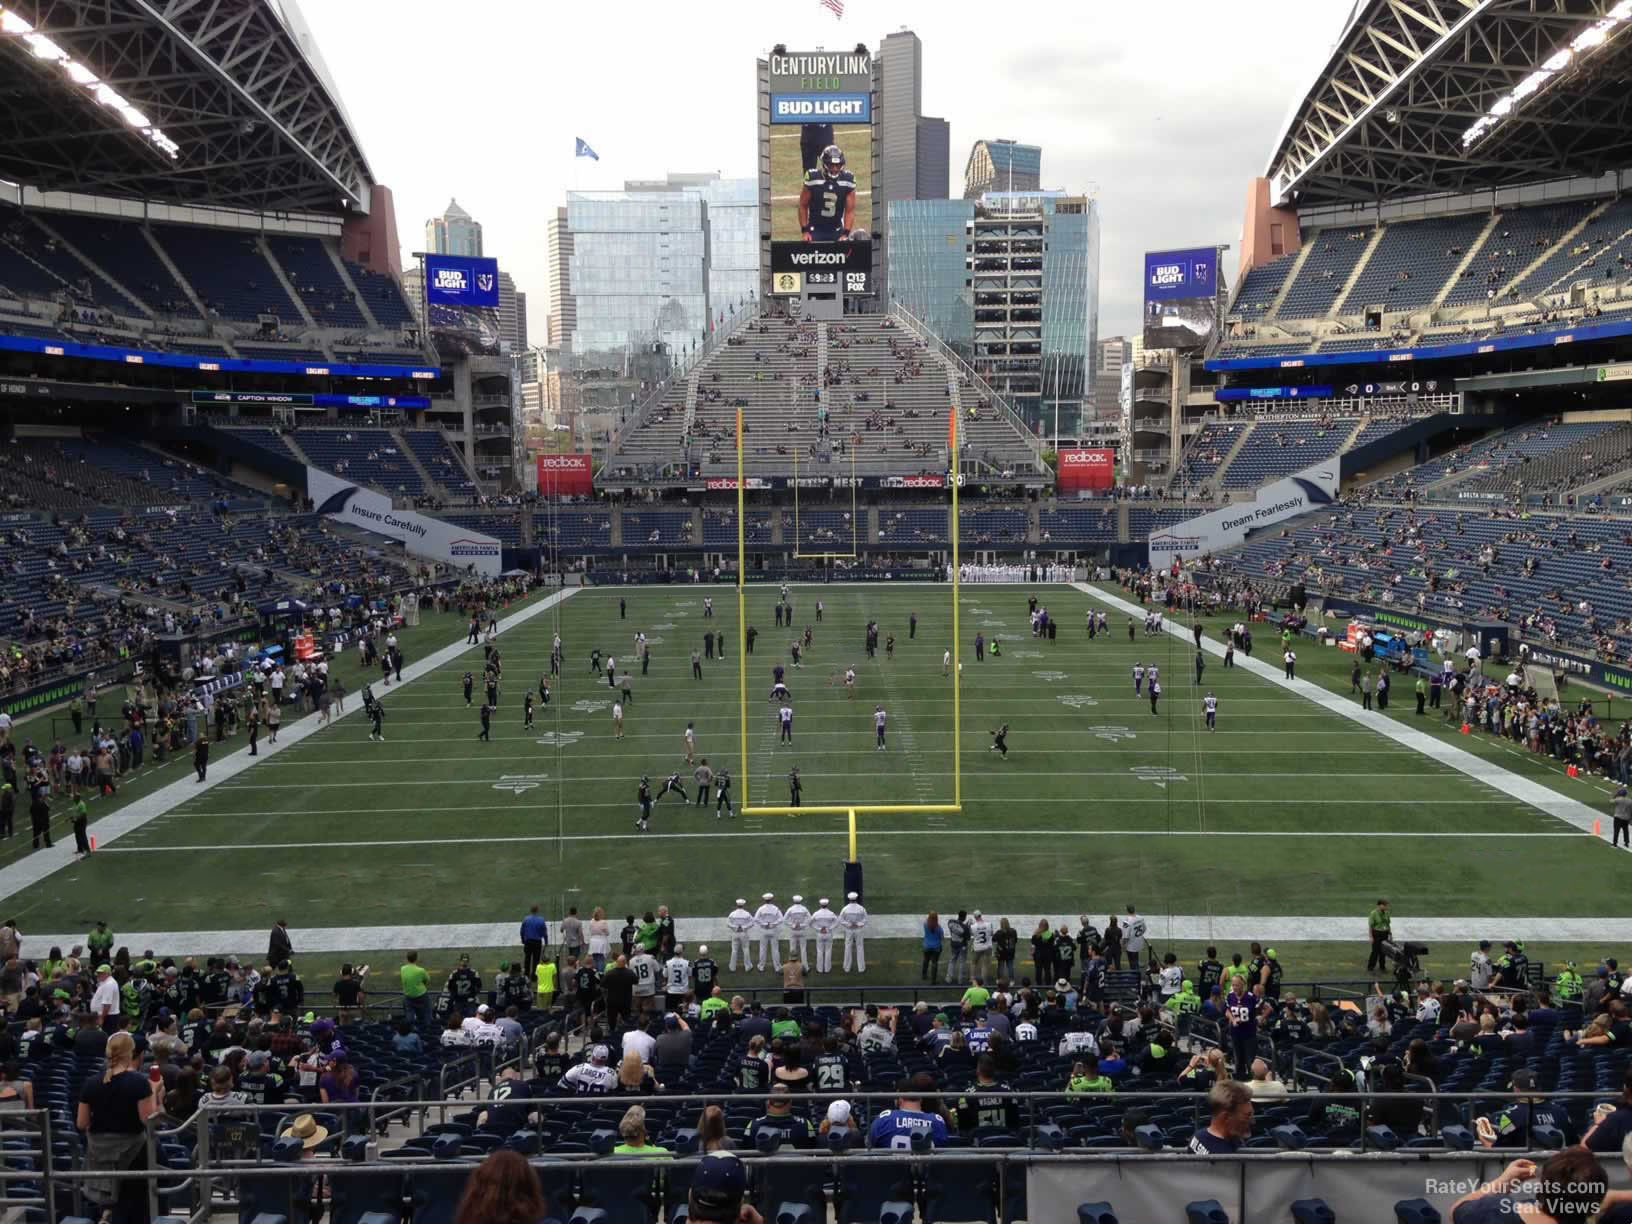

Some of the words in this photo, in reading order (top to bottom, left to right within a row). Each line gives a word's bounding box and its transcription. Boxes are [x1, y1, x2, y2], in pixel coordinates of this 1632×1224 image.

[801, 78, 840, 89] FIELD
[779, 101, 813, 115] BUD
[815, 101, 862, 115] LIGHT
[821, 192, 837, 217] 3
[791, 250, 846, 264] verizon
[439, 270, 462, 280] BUD
[1156, 266, 1180, 275] BUD
[435, 278, 467, 289] LIGHT
[846, 273, 866, 283] Q13
[1152, 274, 1184, 284] LIGHT
[848, 283, 864, 292] FOX
[352, 503, 382, 522] Insure
[383, 514, 427, 537] Carefully
[1222, 514, 1254, 531] Dream
[1255, 496, 1304, 520] Fearlessly
[636, 963, 650, 979] 18
[673, 969, 682, 983] 3
[698, 967, 712, 982] 89
[456, 980, 472, 996] 12
[1180, 1002, 1201, 1014] 54
[1230, 1007, 1249, 1022] 28
[19, 1041, 31, 1058] 3
[817, 1064, 845, 1089] 29
[978, 1097, 1003, 1107] WAGNER
[896, 1117, 933, 1129] LARGENT
[977, 1108, 1006, 1128] 54
[1535, 1113, 1554, 1126] FAN
